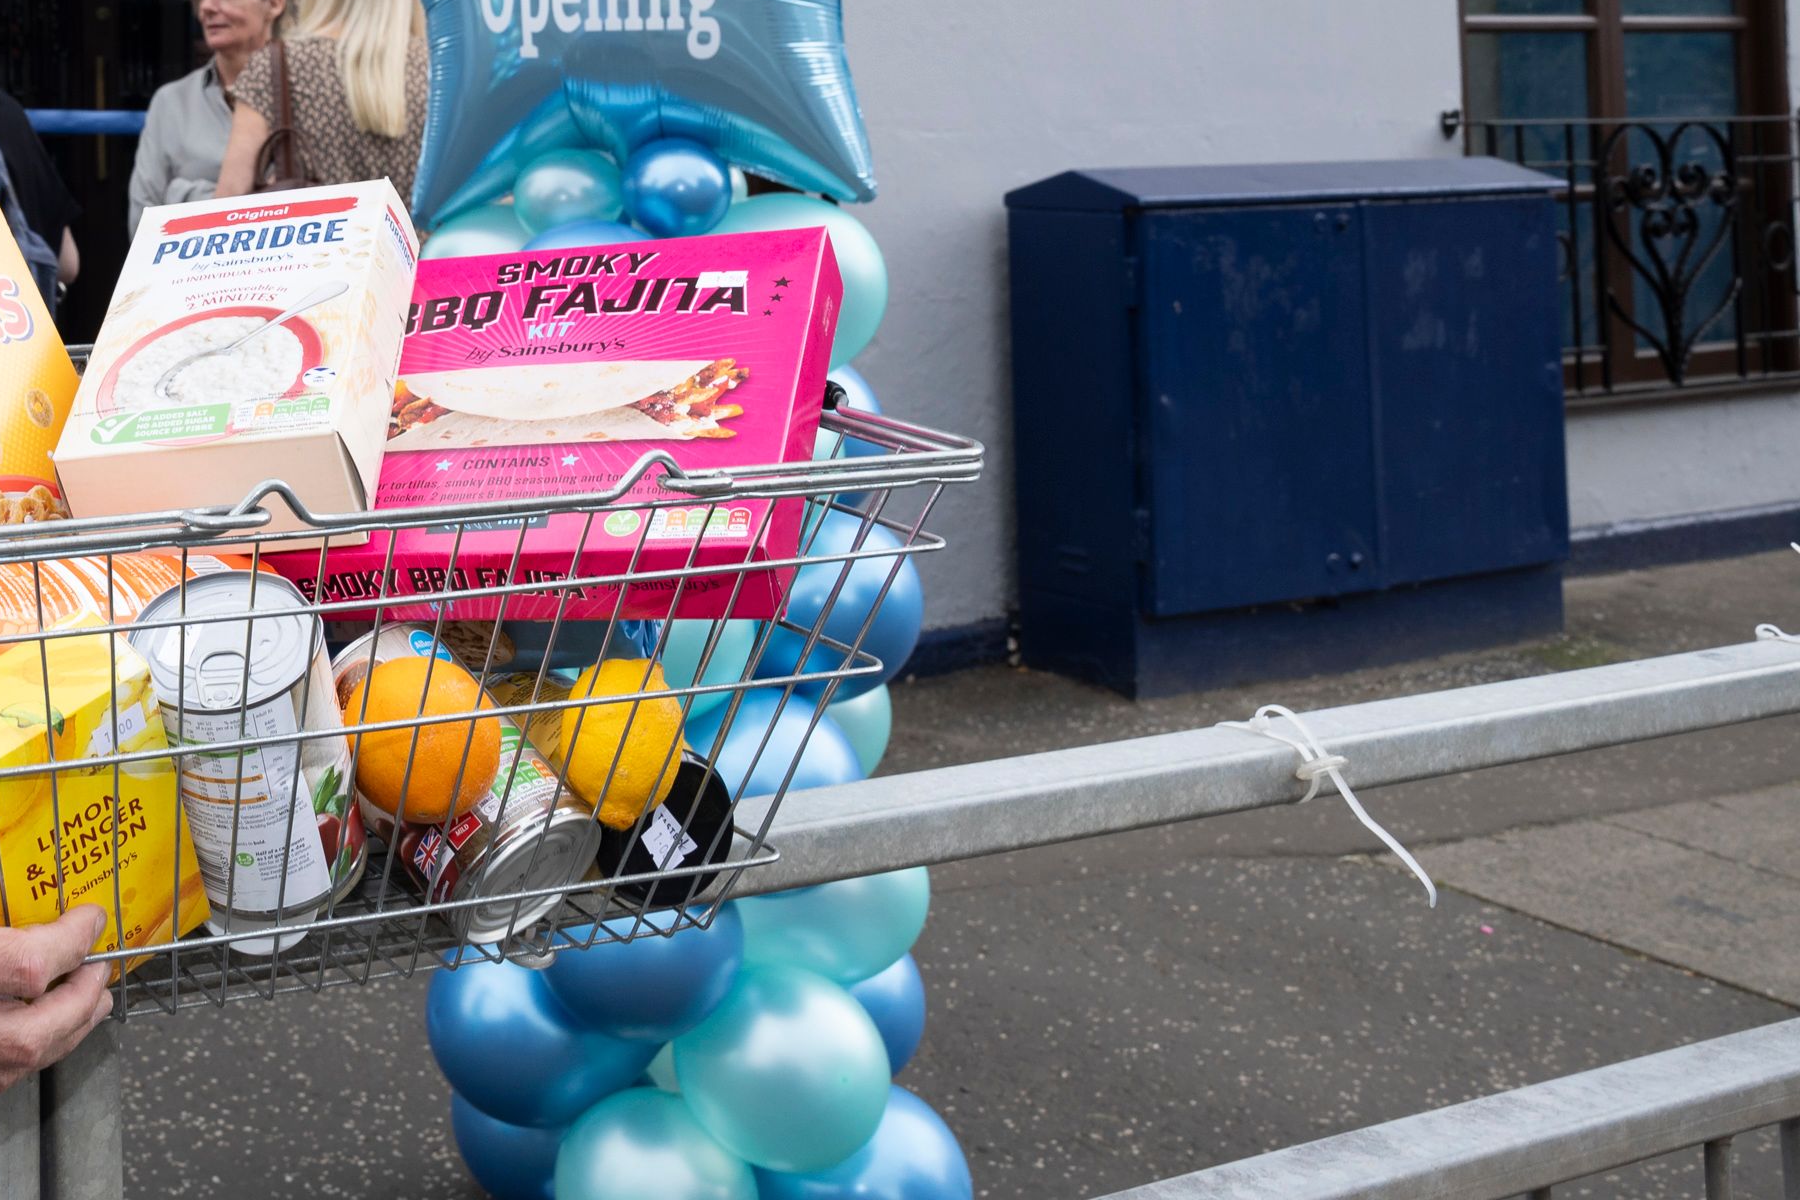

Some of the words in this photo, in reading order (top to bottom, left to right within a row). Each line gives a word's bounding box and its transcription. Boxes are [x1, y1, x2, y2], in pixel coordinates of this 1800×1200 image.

[226, 206, 290, 222] Original
[152, 218, 349, 265] PORRIDGE
[191, 261, 209, 272] by
[211, 252, 295, 268] Sainsbury's
[496, 251, 661, 286] SMOKY
[185, 269, 253, 283] INDIVIDUAL
[256, 263, 310, 275] SACHETS
[184, 284, 276, 302] Microwaveable
[186, 302, 196, 311] 2
[202, 293, 279, 307] MINUTES
[521, 280, 750, 321] FAJITA
[527, 321, 575, 340] KIT
[466, 346, 495, 364] by
[498, 336, 627, 360] Sainsbury's
[137, 422, 151, 431] NO
[152, 419, 183, 429] ADDED
[184, 416, 216, 426] SUGAR
[138, 414, 152, 423] NO
[153, 411, 185, 421] ADDED
[186, 408, 208, 418] SALT
[135, 429, 170, 439] SOURCE
[171, 426, 184, 434] OF
[185, 423, 213, 433] FIBRE
[462, 455, 551, 471] CONTAINS
[390, 478, 441, 493] tortillas,
[444, 476, 485, 491] smoky
[486, 473, 513, 487] BBQ
[514, 471, 579, 487] seasoning
[580, 471, 604, 484] and
[431, 492, 439, 502] 2
[440, 489, 486, 504] peppers
[504, 486, 539, 499] onion
[540, 485, 561, 497] and
[297, 568, 401, 602] SMOKY
[406, 566, 471, 594] BBQ
[429, 600, 455, 613] KT
[36, 794, 121, 853] LEMON
[455, 823, 469, 837] MILD
[26, 863, 45, 881] &
[53, 797, 143, 863] GINGER
[30, 816, 147, 901] INFUSION
[71, 850, 138, 900] Sainsbury's
